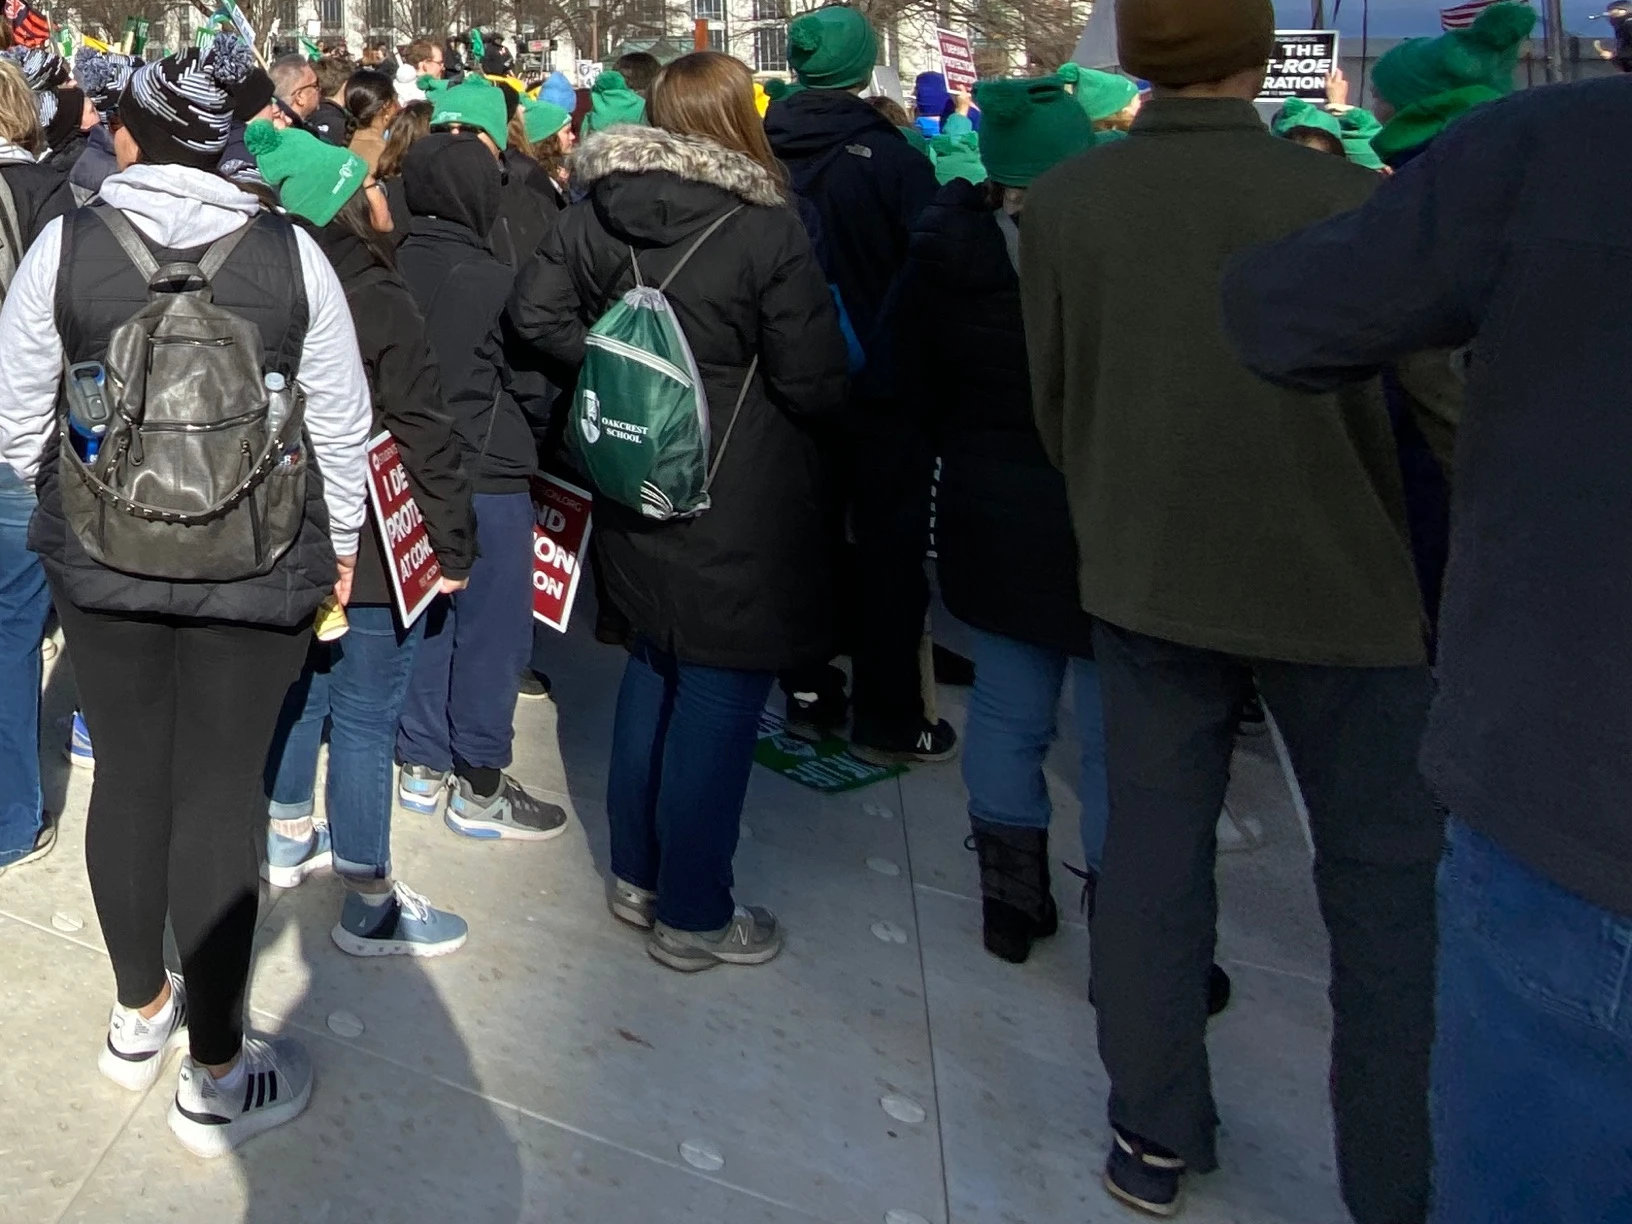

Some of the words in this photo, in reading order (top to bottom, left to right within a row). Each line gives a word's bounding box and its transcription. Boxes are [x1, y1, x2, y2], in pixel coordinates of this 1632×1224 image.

[1281, 44, 1326, 57] THE
[1262, 76, 1325, 89] RATION
[601, 417, 649, 435] OAKCREST
[606, 427, 643, 444] SCHOOL
[382, 474, 393, 502] I
[399, 556, 413, 584] AT
